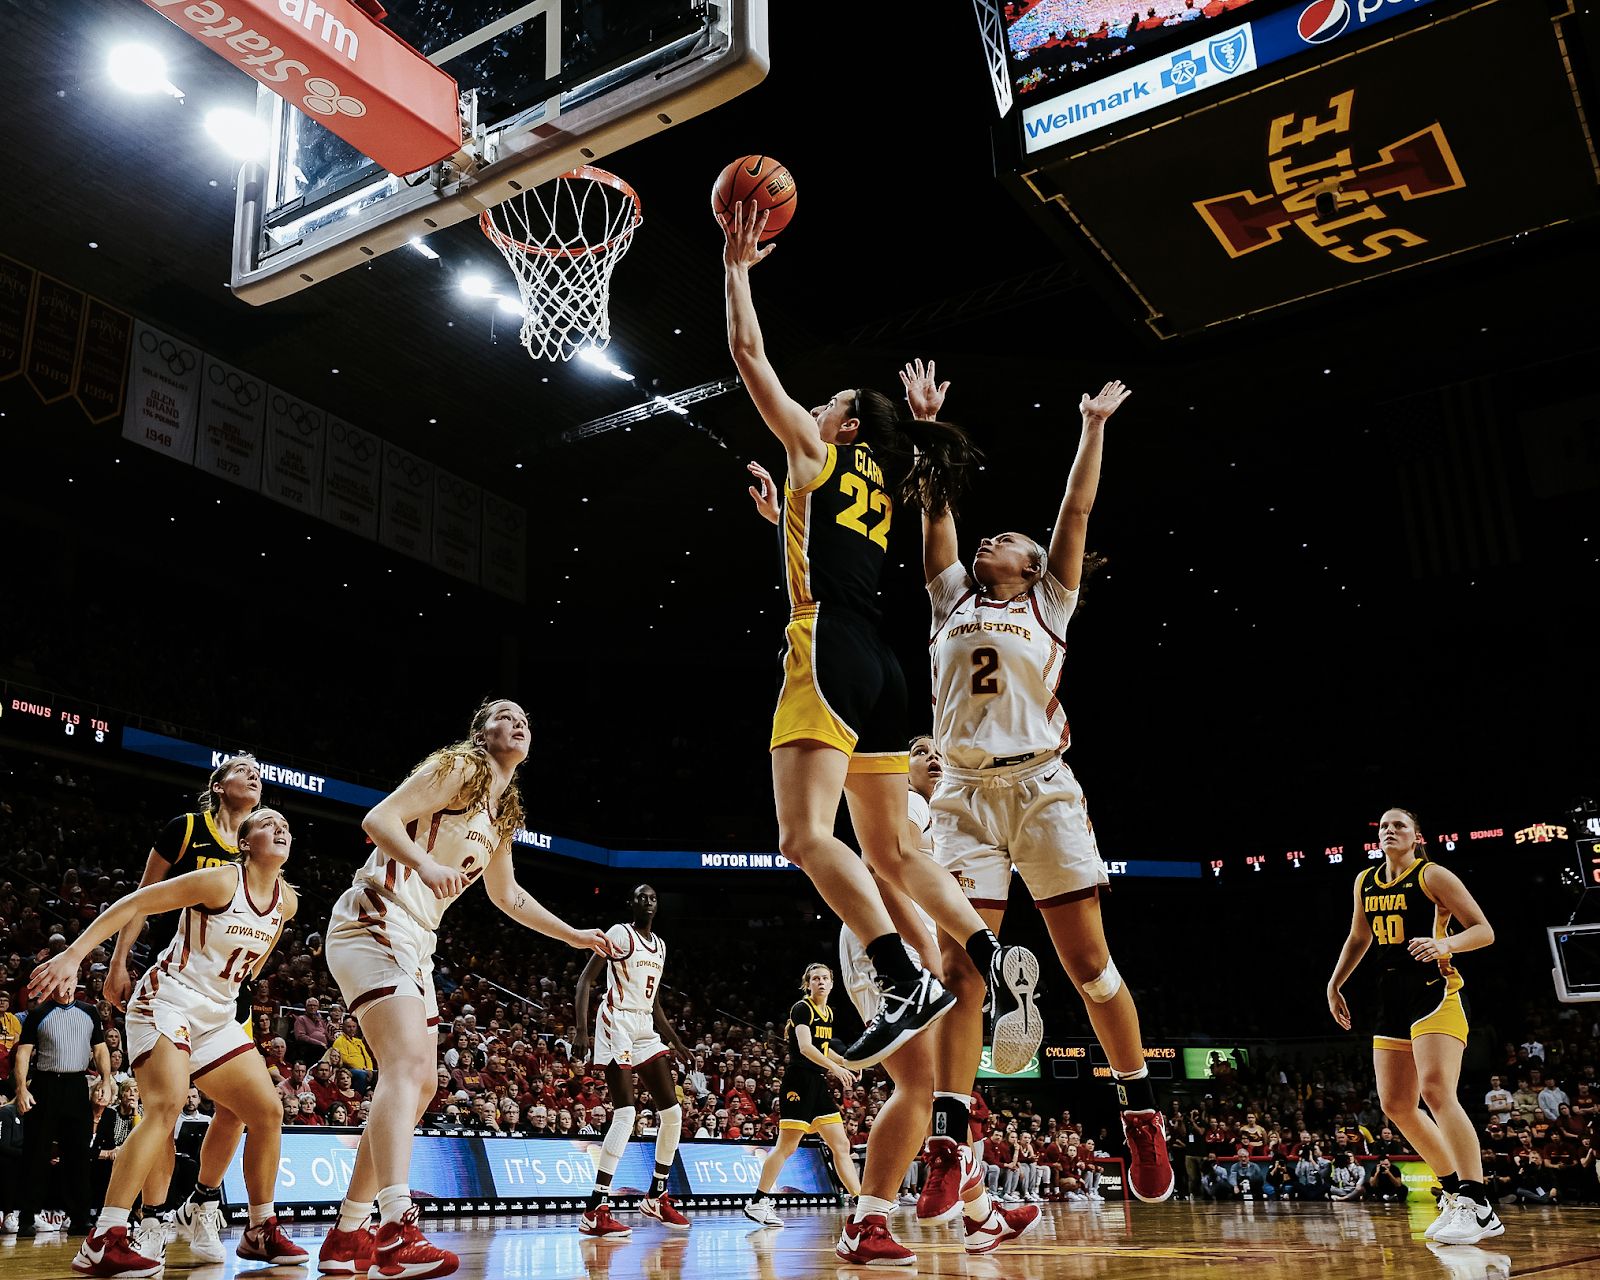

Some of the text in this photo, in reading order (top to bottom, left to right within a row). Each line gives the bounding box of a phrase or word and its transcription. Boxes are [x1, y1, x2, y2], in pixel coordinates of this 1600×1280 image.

[183, 0, 311, 83] State
[1025, 78, 1151, 141] Wellmark
[145, 397, 179, 419] BRAND
[145, 428, 172, 448] 1948
[216, 457, 241, 477] 1972
[836, 471, 893, 554] 22
[946, 621, 1031, 641] IOWA STATE
[971, 647, 999, 695] 2
[12, 699, 52, 718] BONUS
[60, 711, 80, 725] FLS
[91, 718, 110, 733] TOL
[65, 723, 105, 743] 0 3
[255, 762, 325, 793] HEVROLET
[1246, 855, 1265, 865] BLK
[1286, 851, 1305, 861] STL
[1325, 846, 1344, 856] AST
[1439, 833, 1459, 843] FLS
[1470, 828, 1504, 840] BONUS
[1514, 822, 1569, 845] STATE
[701, 853, 748, 868] MOTOR
[750, 854, 773, 868] INN
[1212, 841, 1456, 877] 7 1 1 10 35 0
[1364, 893, 1408, 913] IOWA
[225, 925, 253, 937] IOWA
[1373, 914, 1405, 945] 40
[219, 947, 261, 983] 13
[645, 975, 656, 999] 5
[1045, 1047, 1086, 1058] CYCLONES
[504, 1157, 594, 1187] IT'S ON
[694, 1159, 723, 1184] IT'S
